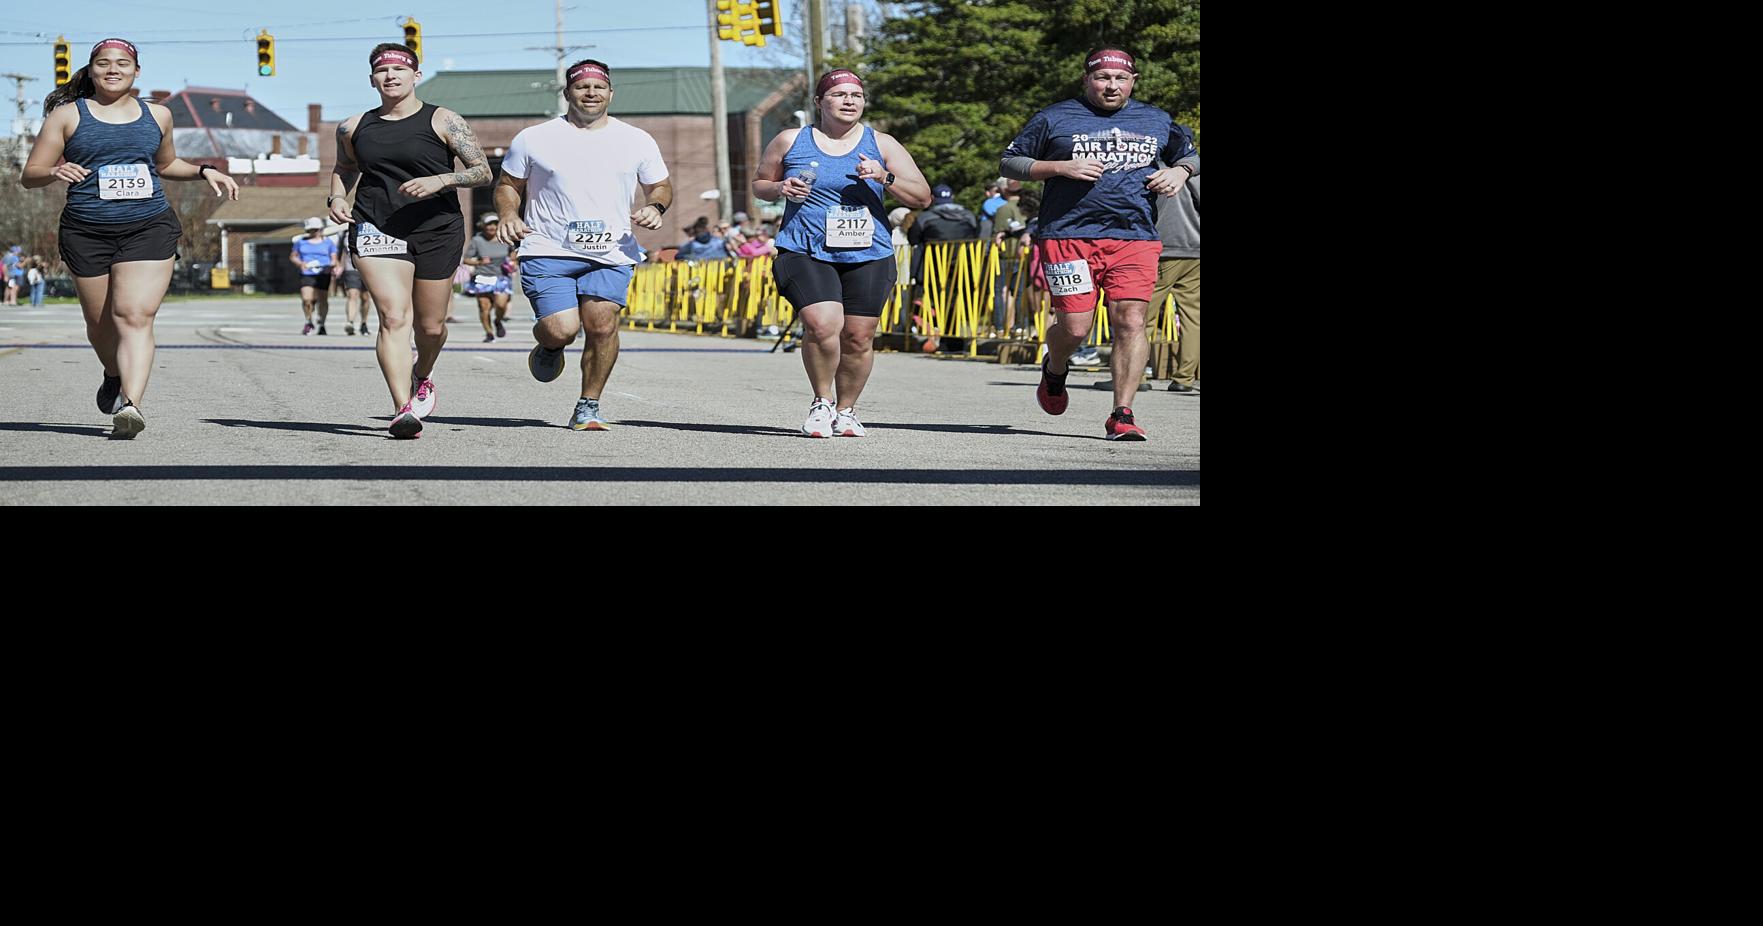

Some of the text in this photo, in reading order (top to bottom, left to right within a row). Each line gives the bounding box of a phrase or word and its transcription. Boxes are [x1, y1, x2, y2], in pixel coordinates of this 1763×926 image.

[1072, 142, 1158, 154] AIR FORCE
[108, 178, 146, 189] 2139
[576, 221, 602, 229] HALF
[836, 218, 868, 229] 2117
[575, 232, 613, 243] 2272
[1052, 273, 1082, 286] 2118
